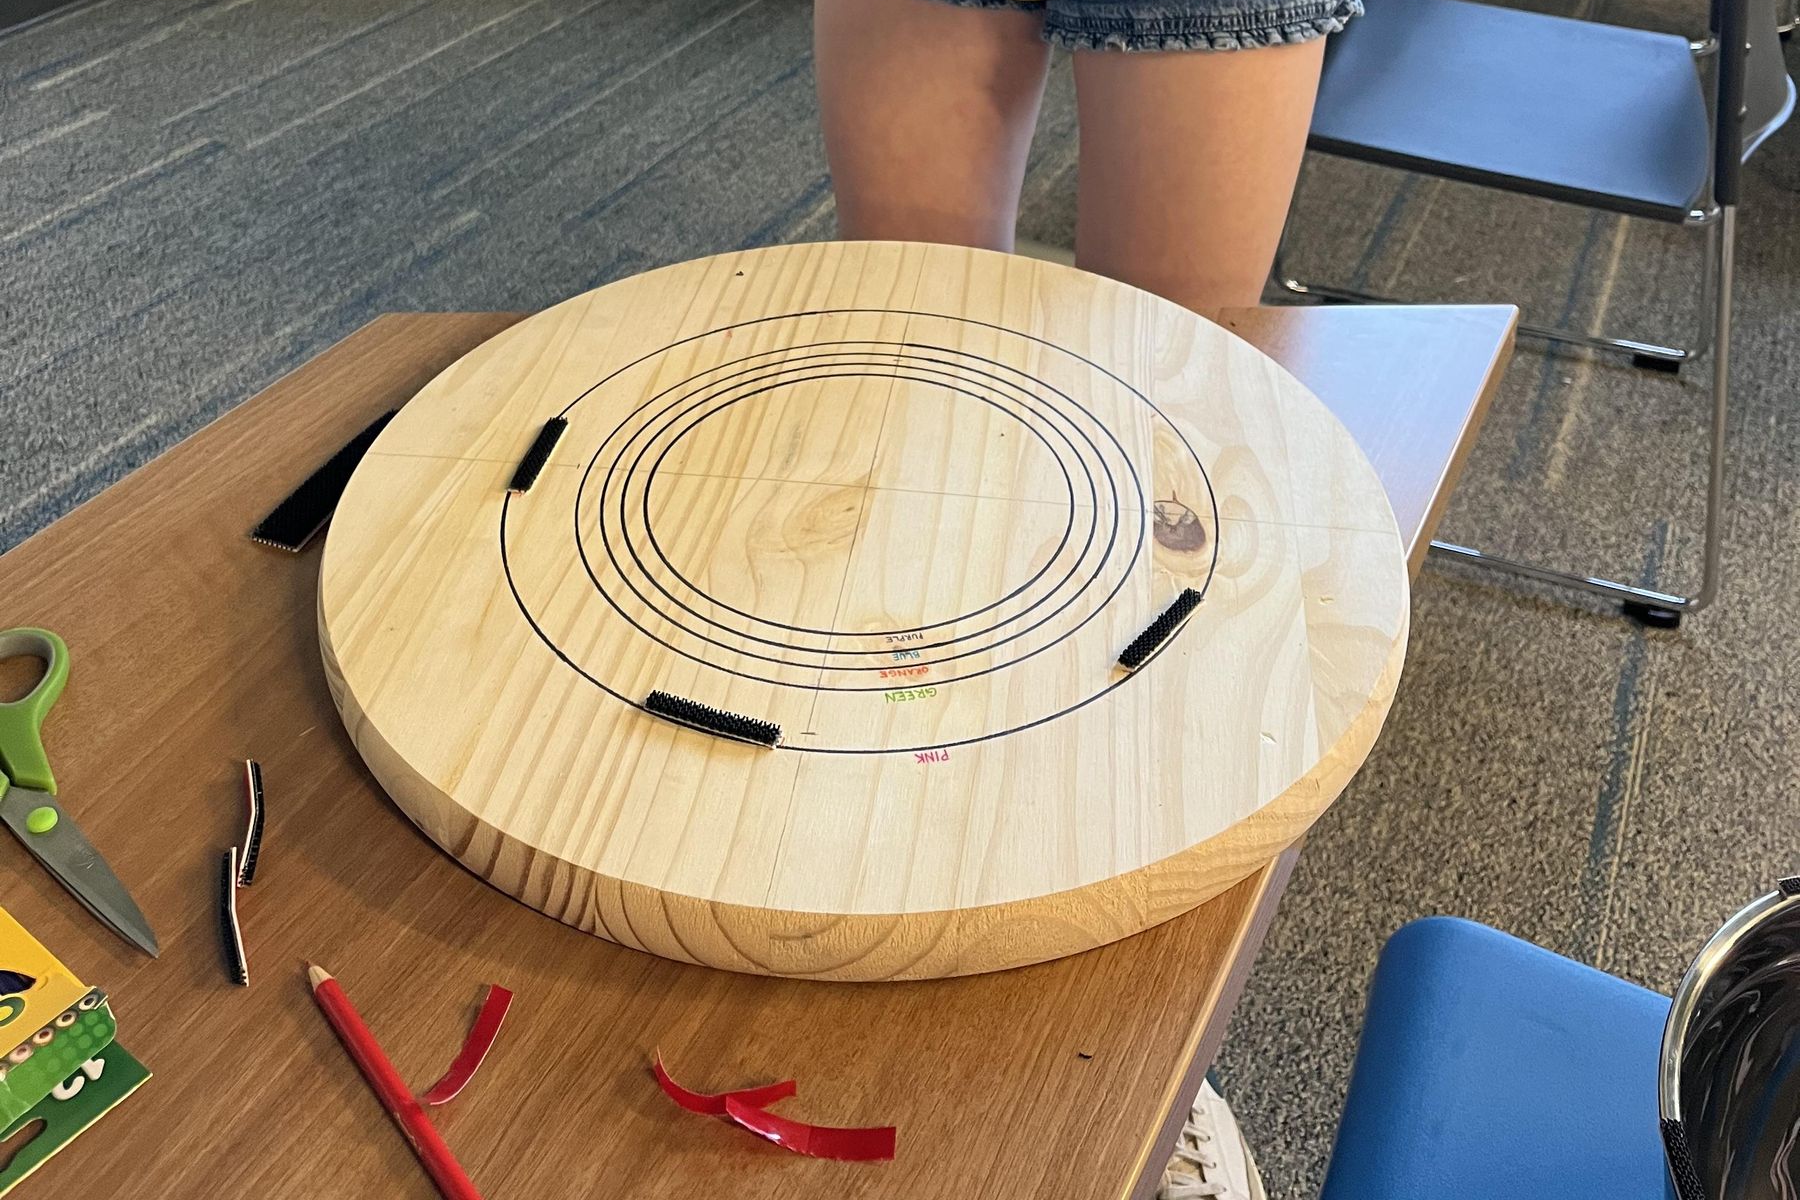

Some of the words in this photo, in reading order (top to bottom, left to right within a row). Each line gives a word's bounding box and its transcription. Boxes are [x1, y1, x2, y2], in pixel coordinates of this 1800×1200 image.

[886, 632, 924, 643] PURPLE
[892, 651, 920, 661] BLUE
[879, 666, 929, 679] ORANGE
[884, 686, 938, 704] GREEN
[914, 749, 949, 764] PINK
